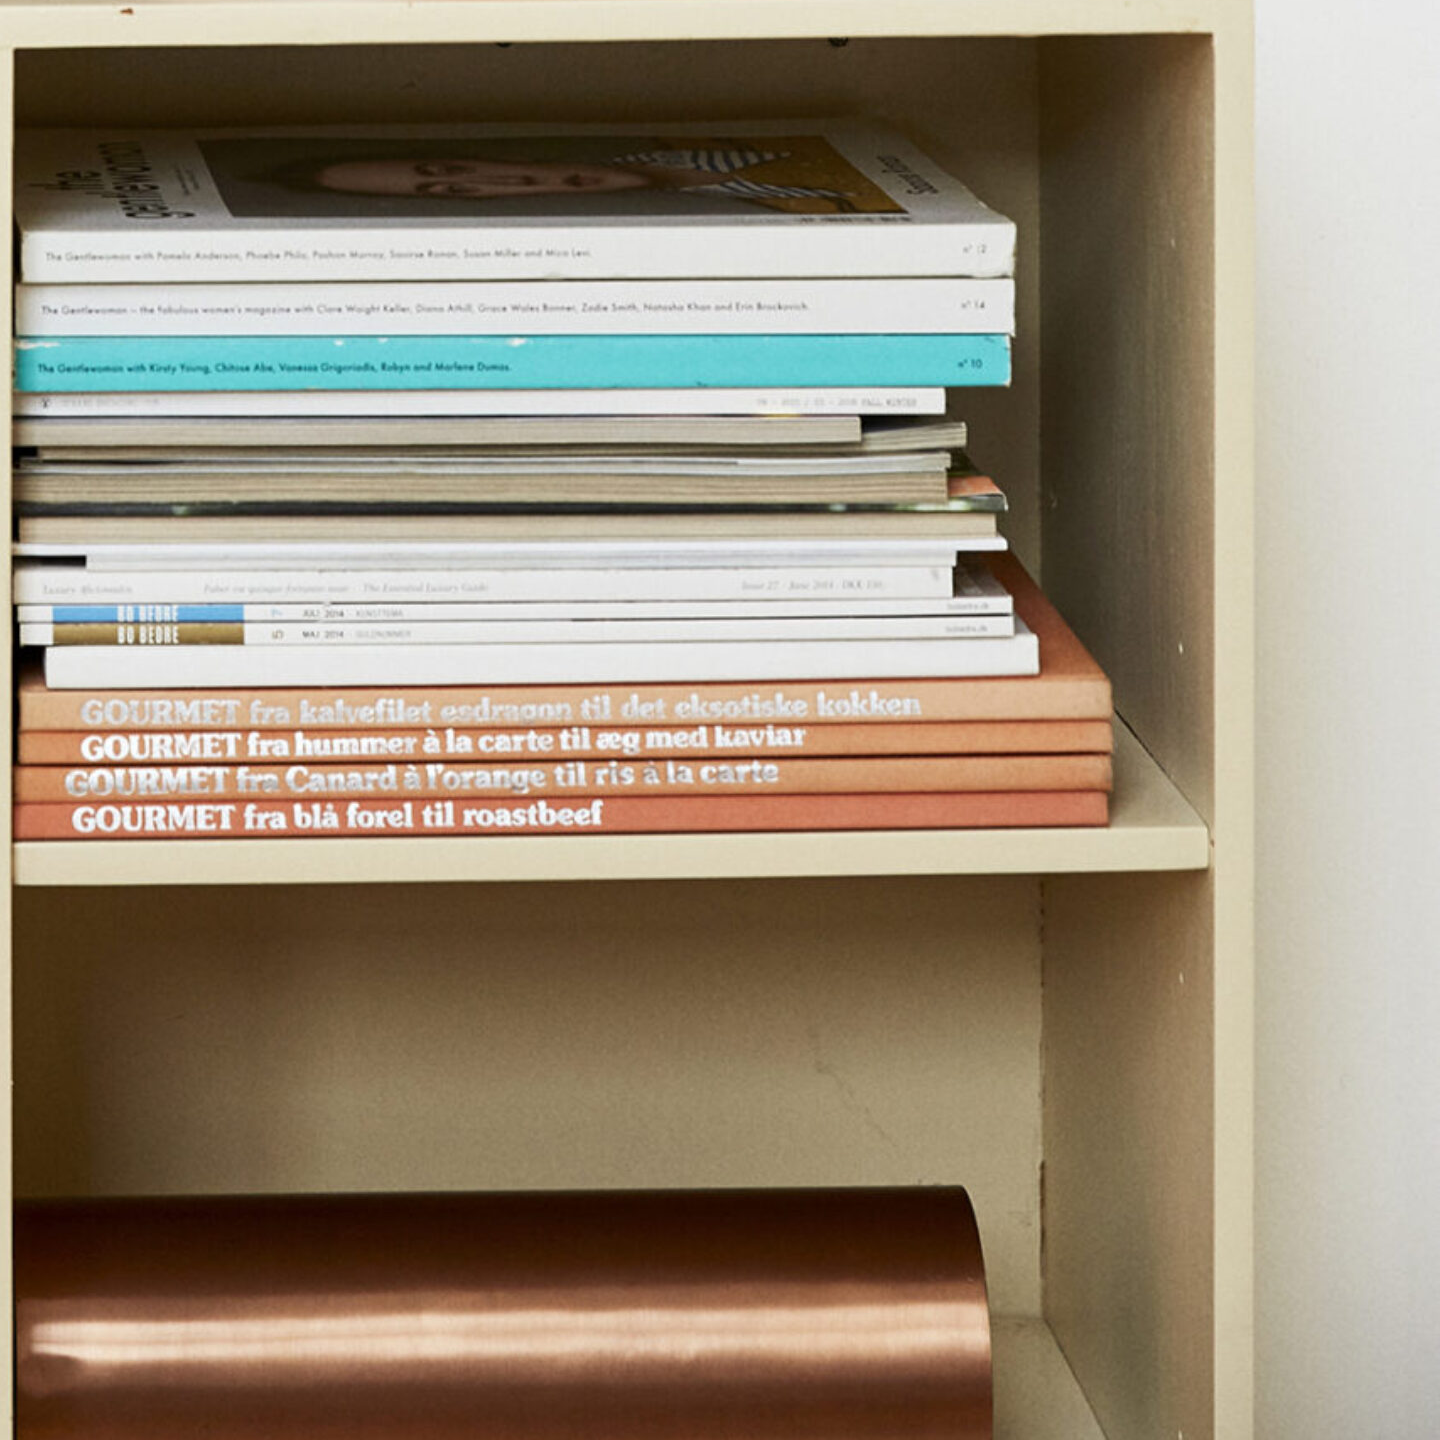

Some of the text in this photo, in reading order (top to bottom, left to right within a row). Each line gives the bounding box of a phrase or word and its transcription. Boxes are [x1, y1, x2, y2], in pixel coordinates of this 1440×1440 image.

[46, 253, 62, 261] The
[65, 253, 130, 261] Gentlewoman
[157, 252, 191, 260] Pamela
[246, 251, 280, 259] Phoebe
[42, 306, 58, 314] The
[62, 306, 127, 315] Gentlewoman
[157, 305, 199, 314] fabulous
[245, 308, 291, 316] magazine
[295, 305, 313, 313] with
[478, 304, 507, 313] Grace
[687, 303, 711, 311] Khan
[715, 303, 732, 311] and
[735, 302, 753, 311] Erin
[38, 364, 54, 373] The
[57, 364, 123, 373] Gentlewoman
[127, 364, 146, 372] with
[149, 364, 176, 374] Kirsty
[180, 364, 210, 374] Young,
[215, 363, 250, 372] Chitose
[254, 363, 275, 372] Abe,
[279, 364, 318, 372] Vanessa
[381, 362, 410, 373] Robyn
[413, 363, 432, 371] and
[435, 363, 474, 371] Marlene
[971, 359, 982, 368] 10
[324, 609, 344, 618] 2014
[117, 625, 179, 644] BO BEDRE
[324, 630, 344, 639] 2014
[80, 699, 241, 726] GOURMET
[249, 700, 290, 724] fra
[299, 697, 431, 724] kalvefilet
[440, 697, 572, 723] esdragon
[581, 695, 611, 719] til
[621, 694, 666, 719] det
[675, 693, 808, 718] eksotiske
[80, 725, 806, 760] GOURMET fra hummer à la carte til æg med kaviar
[65, 769, 229, 796] GOURMET
[236, 768, 279, 793] fra
[285, 767, 396, 793] Canard
[403, 766, 420, 791] à
[554, 761, 587, 786] til
[595, 761, 634, 785] ris
[643, 761, 660, 785] à
[666, 761, 693, 784] la
[700, 761, 779, 783] carte
[72, 799, 603, 832] GOURMET fra blå forel til roastbeef
